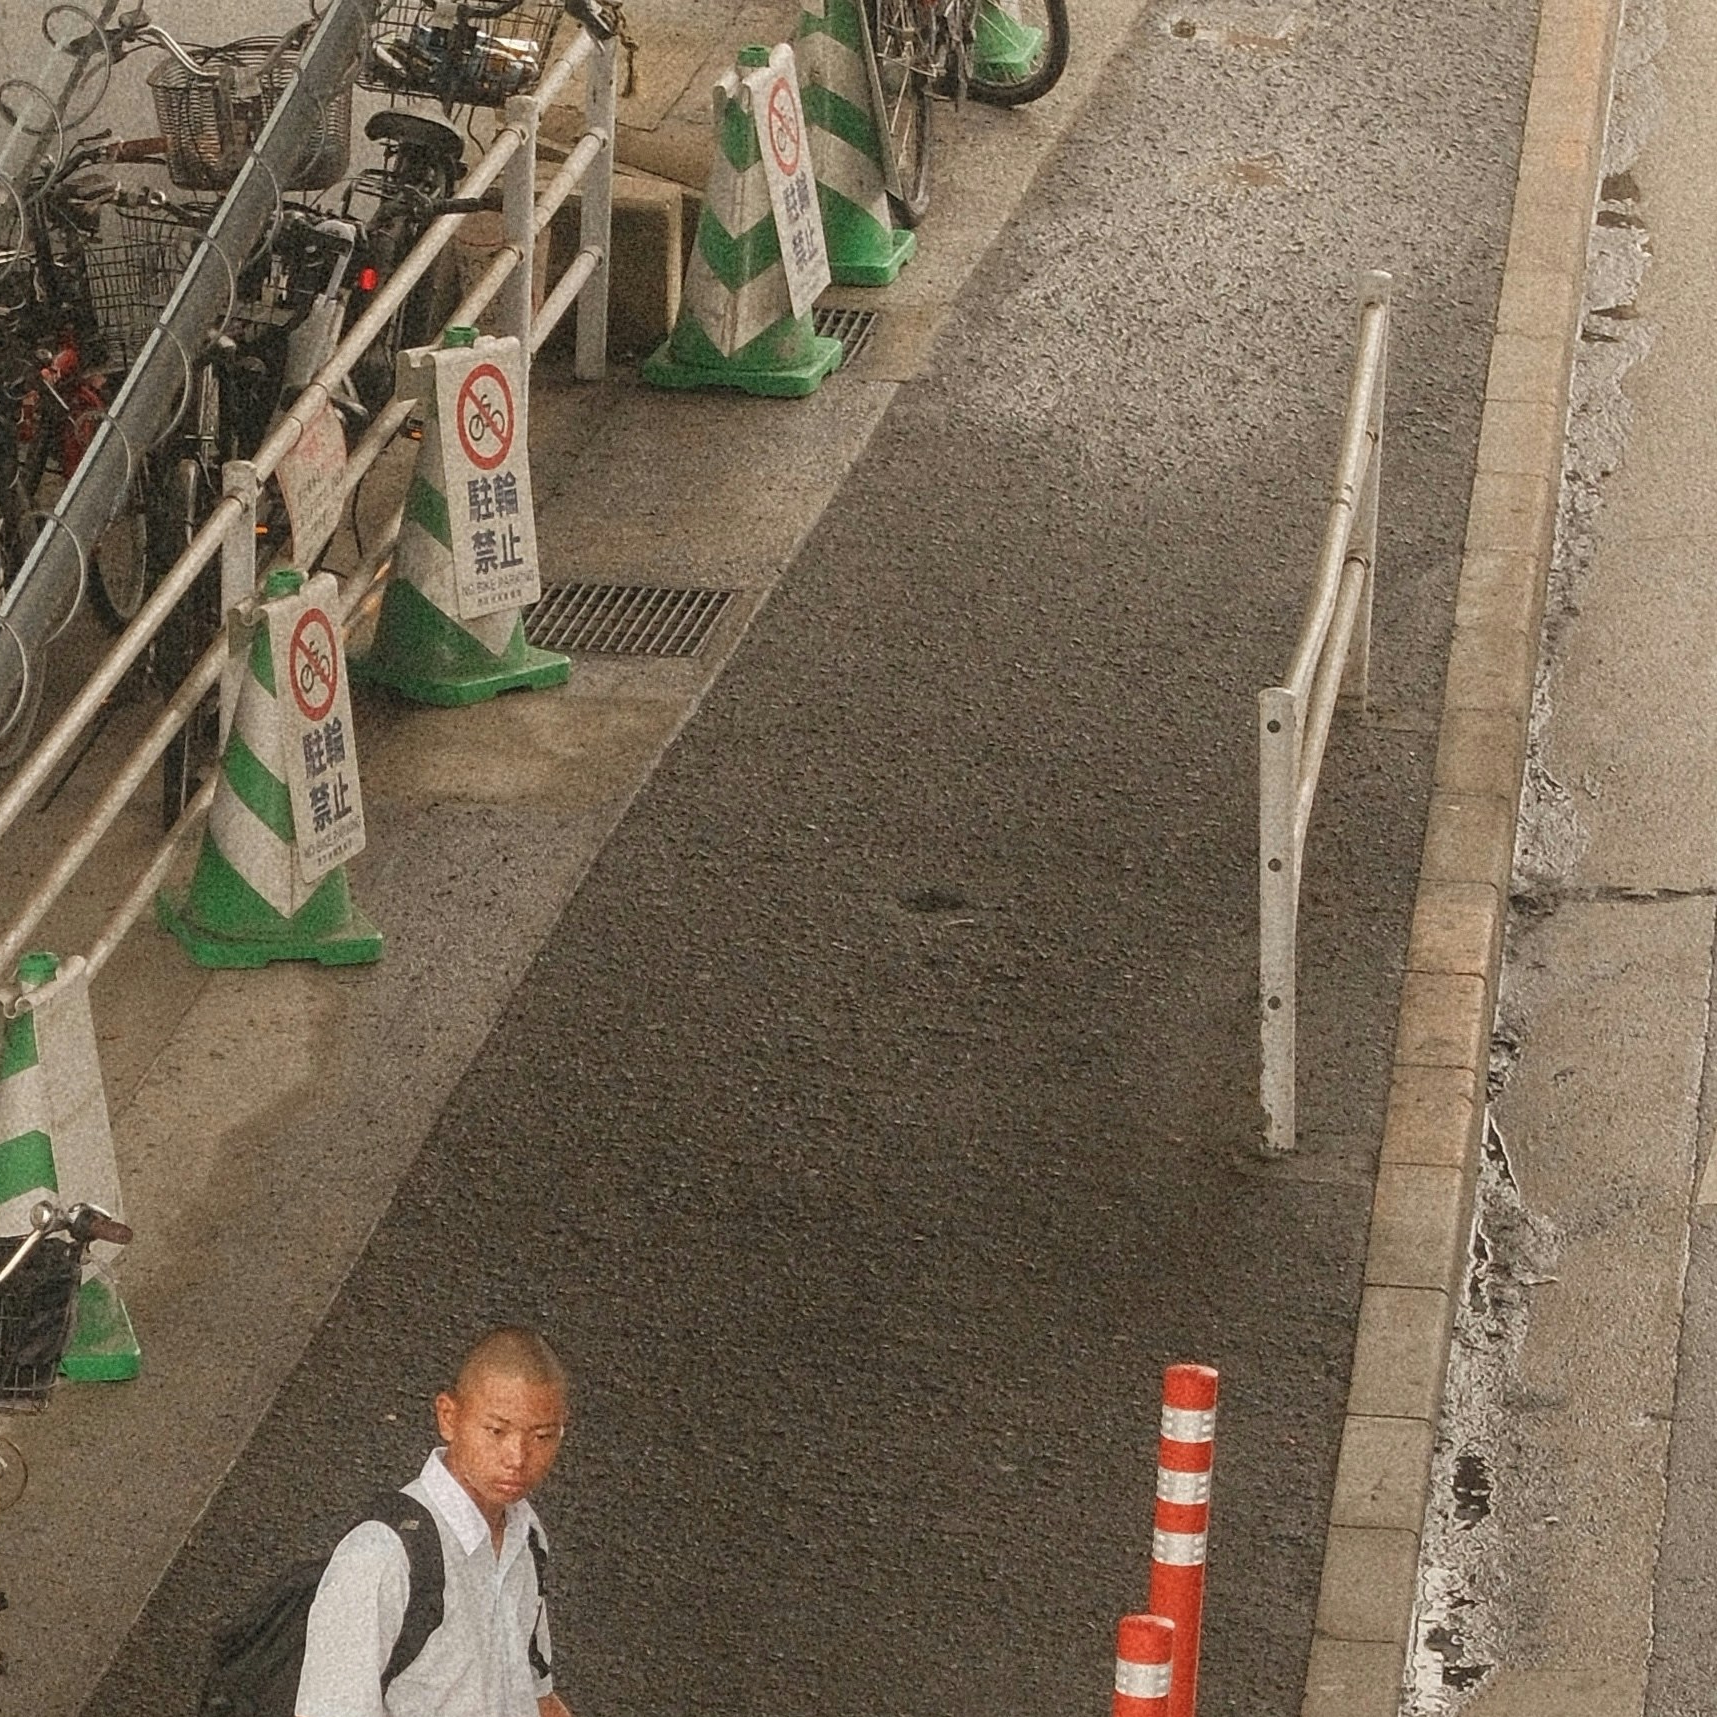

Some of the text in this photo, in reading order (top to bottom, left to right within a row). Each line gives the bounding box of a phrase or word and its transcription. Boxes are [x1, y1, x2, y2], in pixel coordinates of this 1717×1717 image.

[467, 471, 518, 522] 駐輪
[471, 524, 524, 574] 禁止
[302, 717, 345, 779] 駐輪
[309, 772, 352, 833] 禁止
